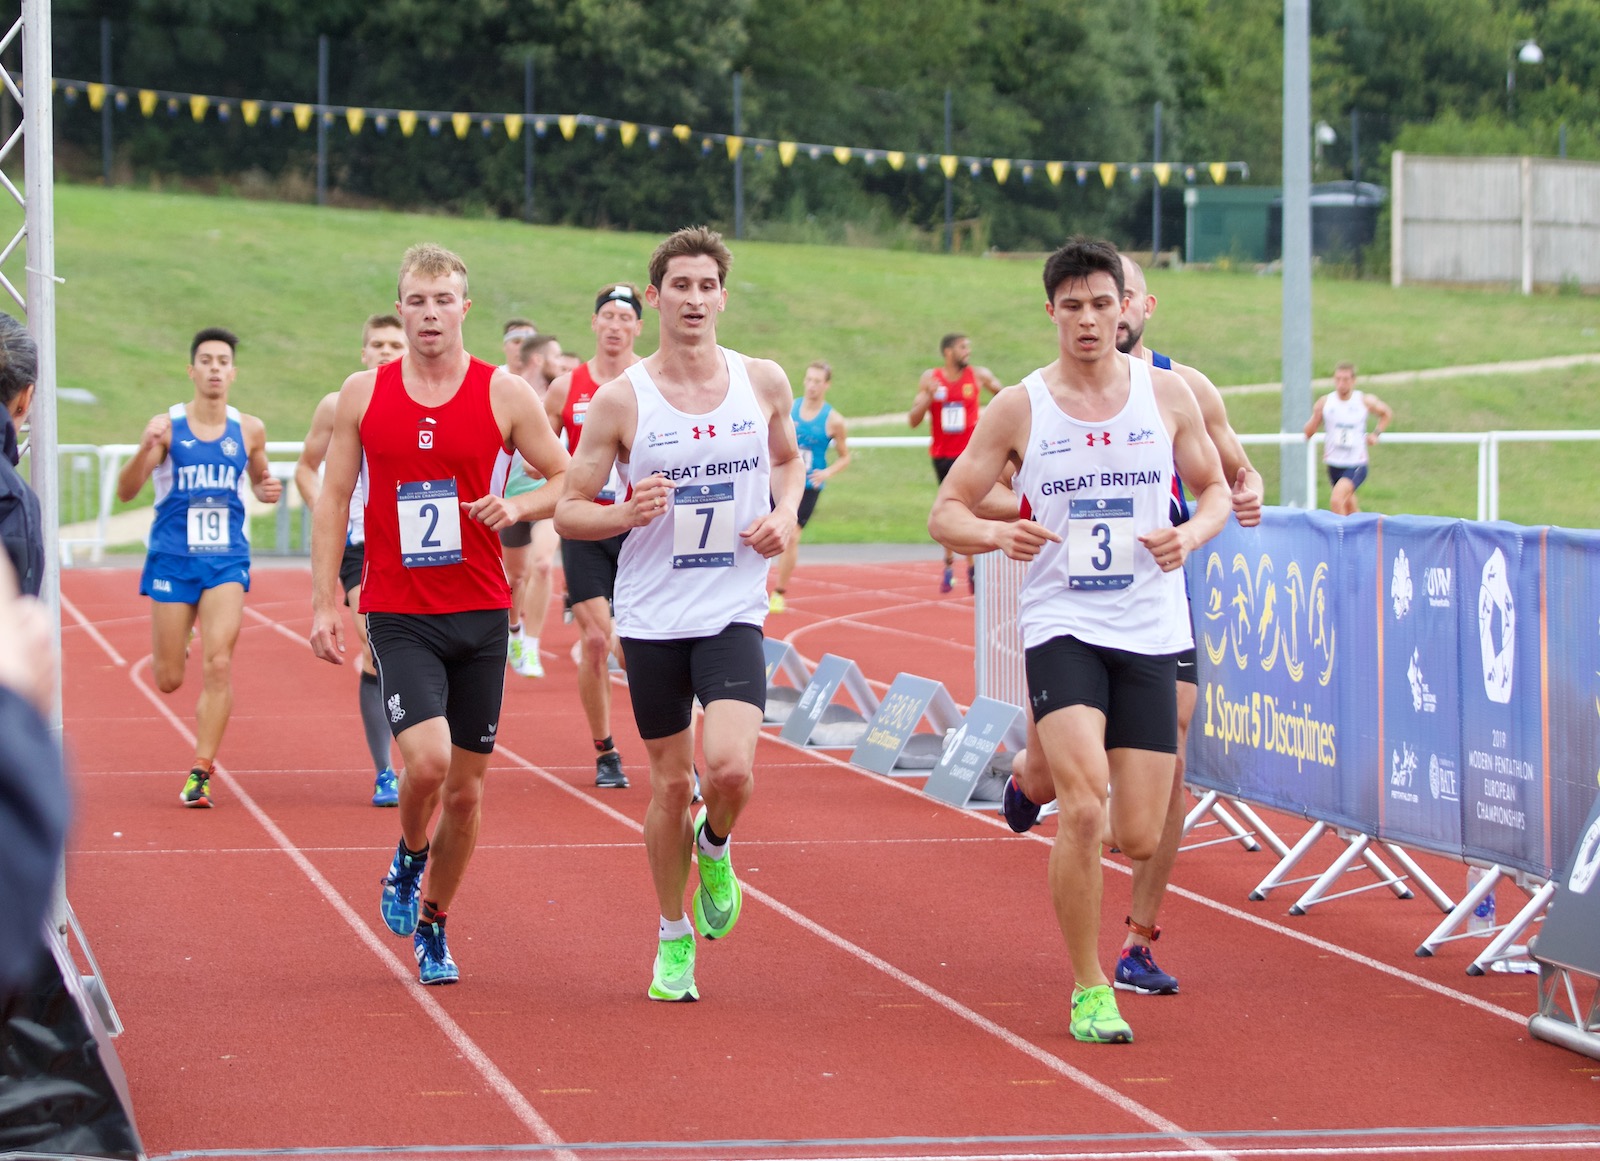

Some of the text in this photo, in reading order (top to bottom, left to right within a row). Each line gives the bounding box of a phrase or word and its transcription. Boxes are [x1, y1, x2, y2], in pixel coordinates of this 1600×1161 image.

[178, 463, 237, 491] ITALIA
[706, 456, 759, 476] BRITAIN
[1041, 470, 1161, 496] GREAT BRITAIN
[195, 511, 221, 541] 19
[419, 503, 441, 548] 2
[696, 507, 714, 549] 7
[1091, 522, 1112, 571] 3
[1204, 682, 1336, 774] 1 Sport 5 Disciplines
[1492, 729, 1506, 749] 2019
[1469, 750, 1493, 771] MODERN
[1494, 755, 1534, 780] PENTATHLON
[1484, 778, 1516, 801] EUROPEAN
[1476, 800, 1525, 830] CHAMPIONSHIPS
